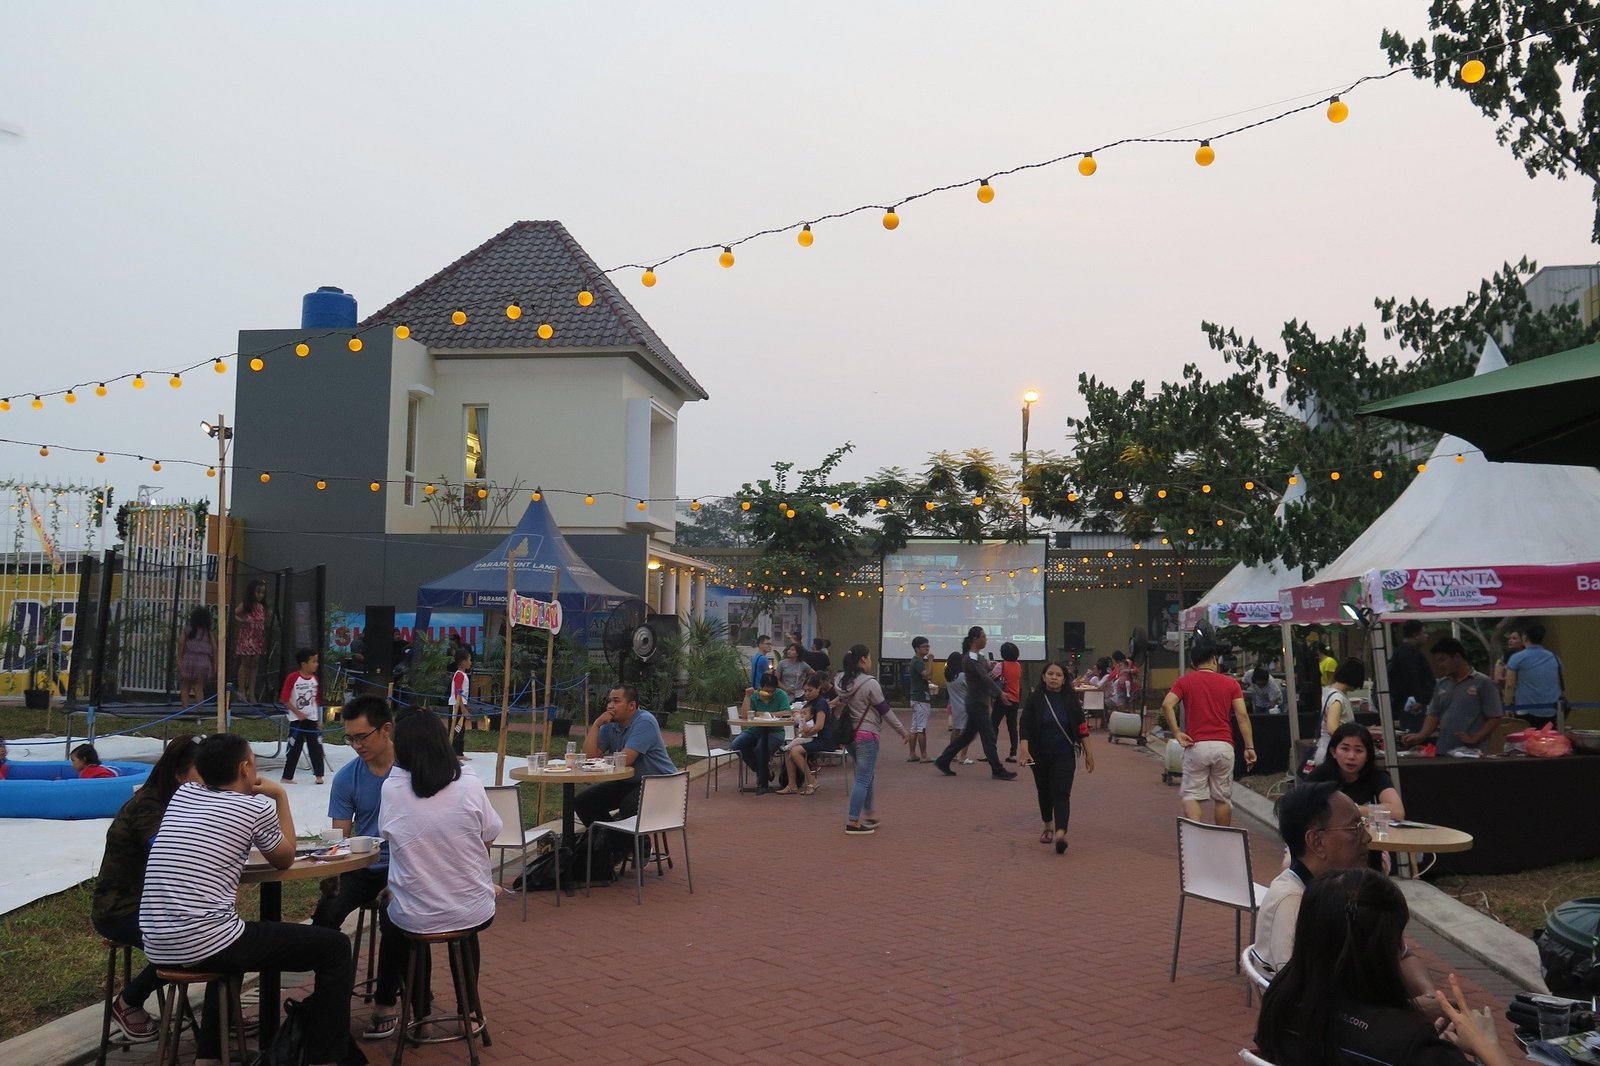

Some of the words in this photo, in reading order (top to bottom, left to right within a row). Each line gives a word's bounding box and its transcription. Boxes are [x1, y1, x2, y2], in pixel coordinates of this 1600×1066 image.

[532, 562, 558, 572] LAND
[1417, 572, 1498, 588] ATLANTA
[1436, 584, 1478, 599] Village
